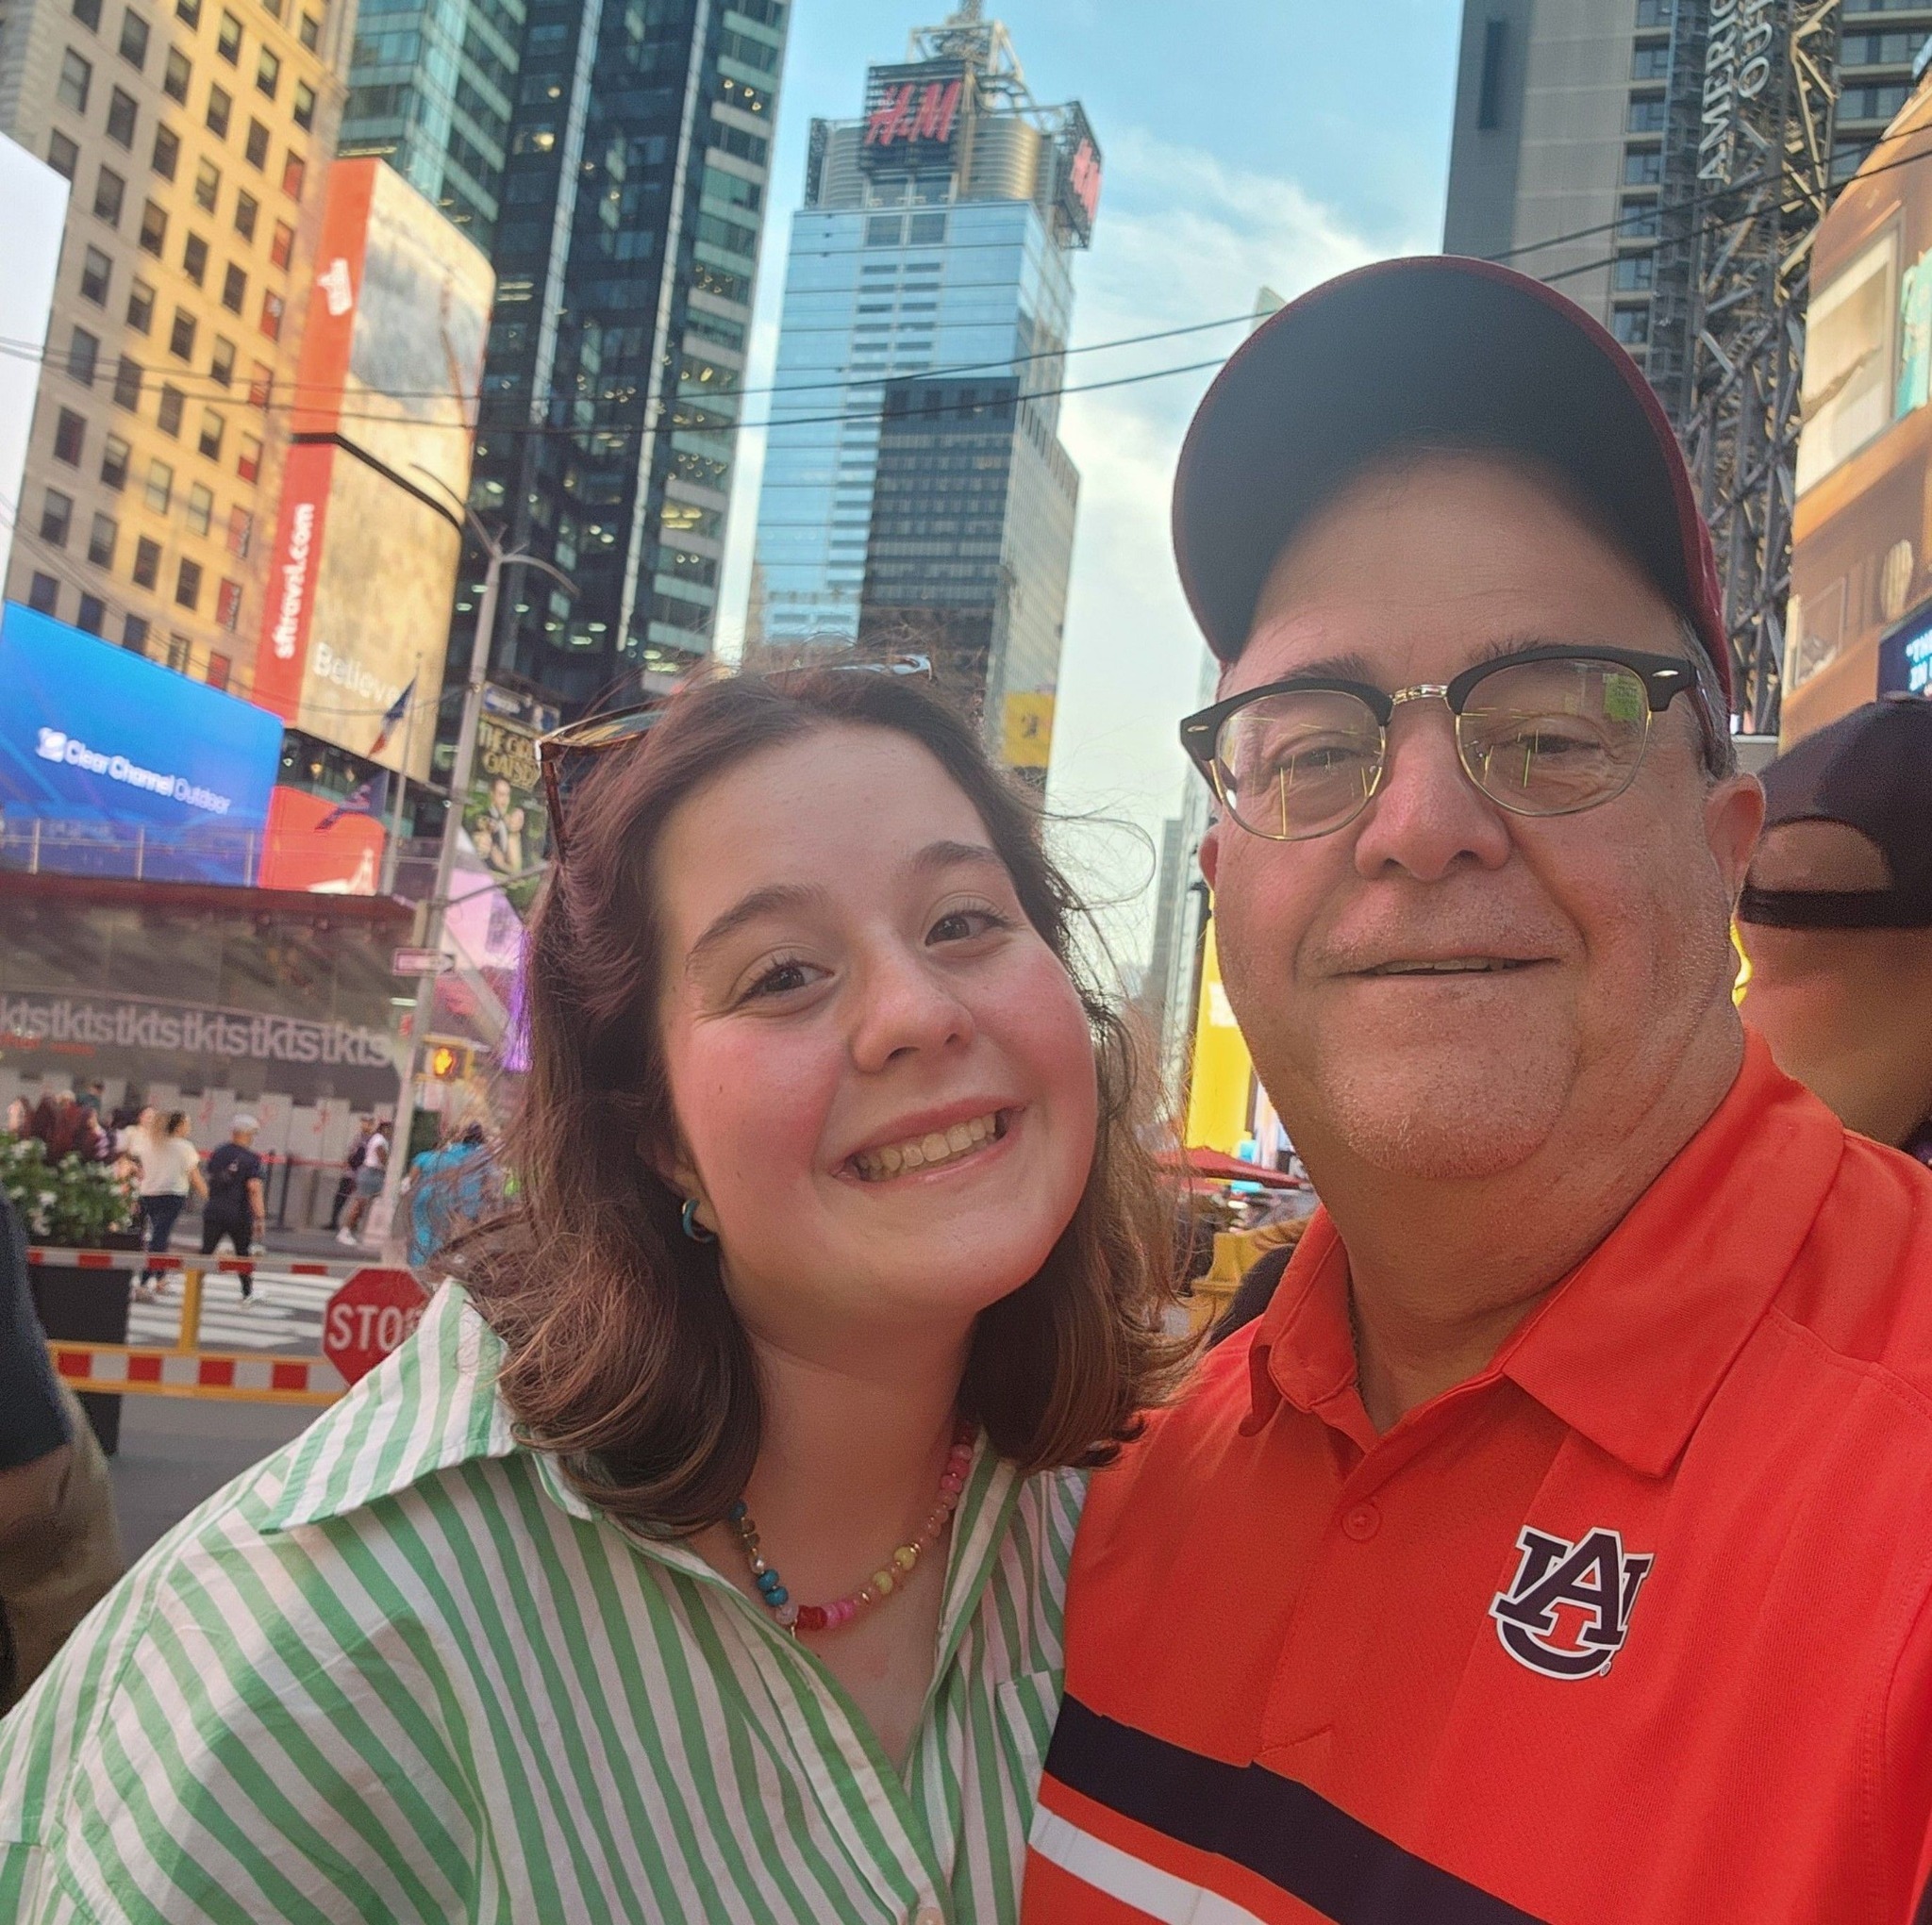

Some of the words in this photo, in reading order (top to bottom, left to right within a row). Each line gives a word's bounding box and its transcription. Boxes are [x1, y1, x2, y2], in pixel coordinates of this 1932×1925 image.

[65, 739, 110, 774] Clear
[108, 755, 175, 797] Channel
[174, 778, 231, 815] Outdoor
